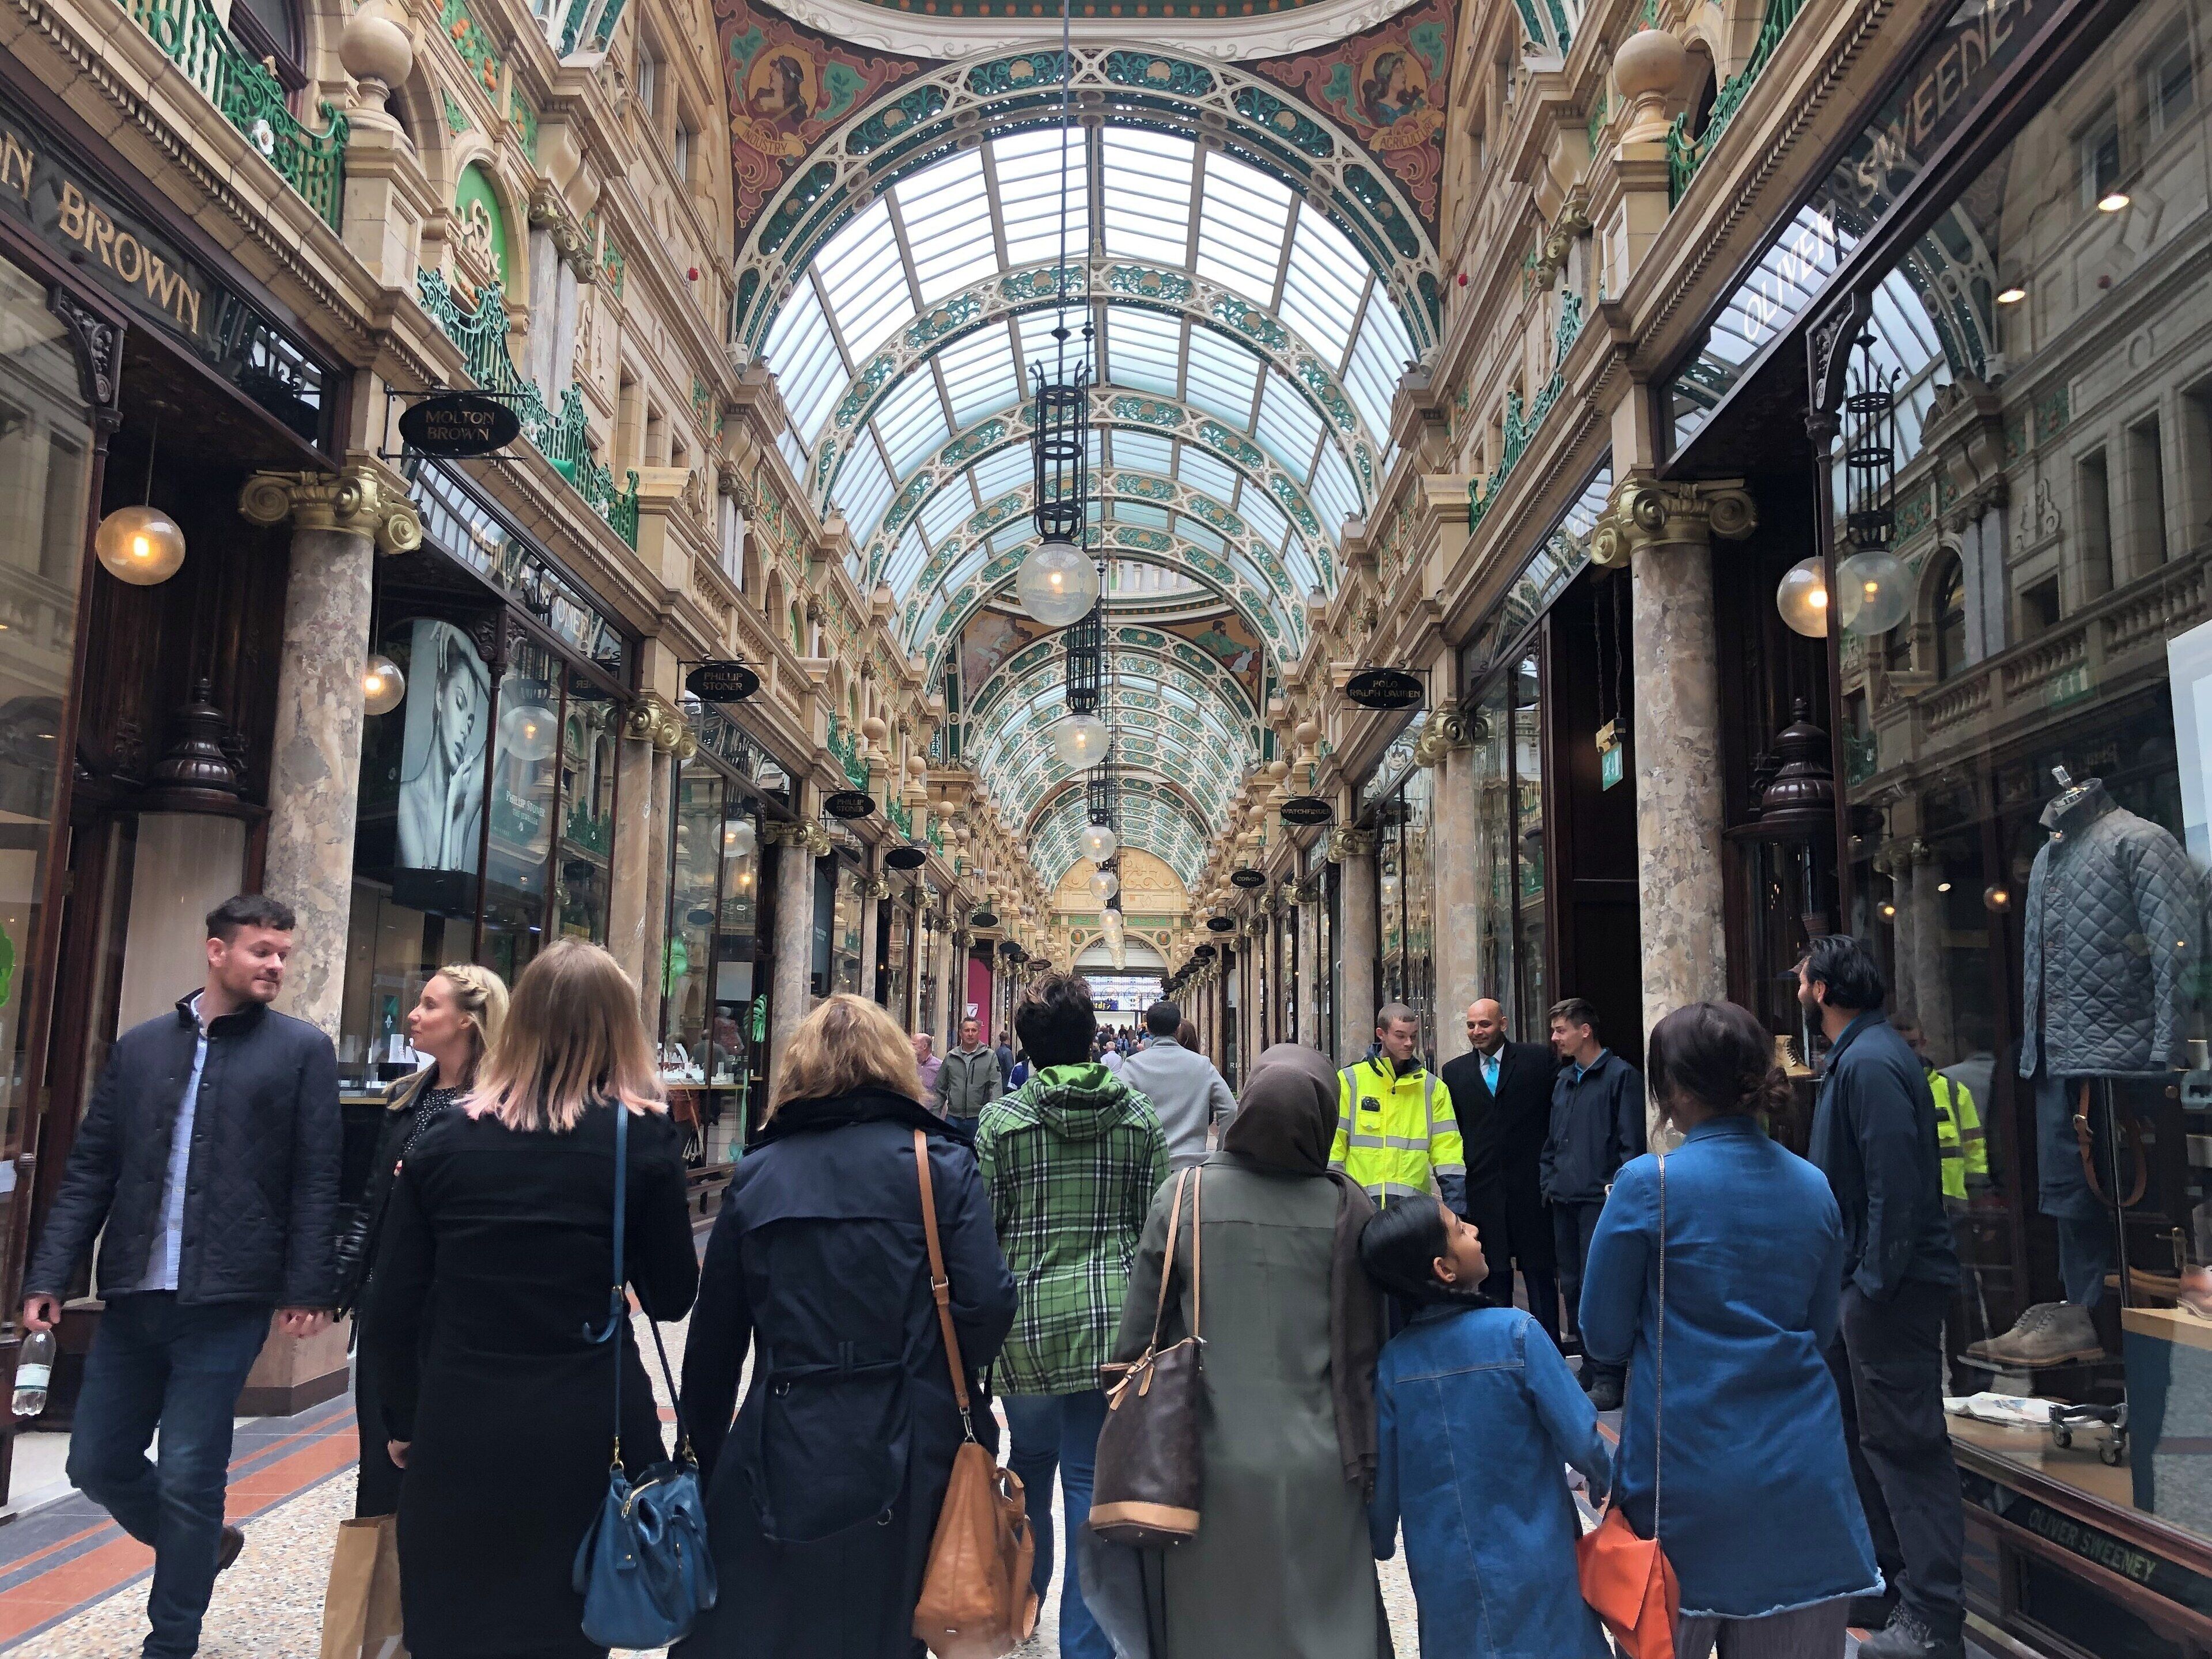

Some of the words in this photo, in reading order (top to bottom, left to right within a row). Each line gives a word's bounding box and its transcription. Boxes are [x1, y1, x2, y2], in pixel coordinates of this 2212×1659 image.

[1381, 113, 1435, 149] AGRICULTURE
[743, 128, 788, 154] INDUSTRY
[59, 180, 200, 335] BROWN
[1743, 199, 1839, 342] OLIVER
[426, 410, 495, 425] MOLTON
[427, 426, 489, 441] BROWN
[704, 672, 743, 681] PHILLIP
[1373, 680, 1398, 688] POLO
[703, 681, 743, 691] STONER
[1350, 689, 1381, 698] RALPH
[1384, 690, 1421, 698] LAUREN
[527, 800, 546, 818] STONER
[2079, 1532, 2157, 1582] SWEENEY
